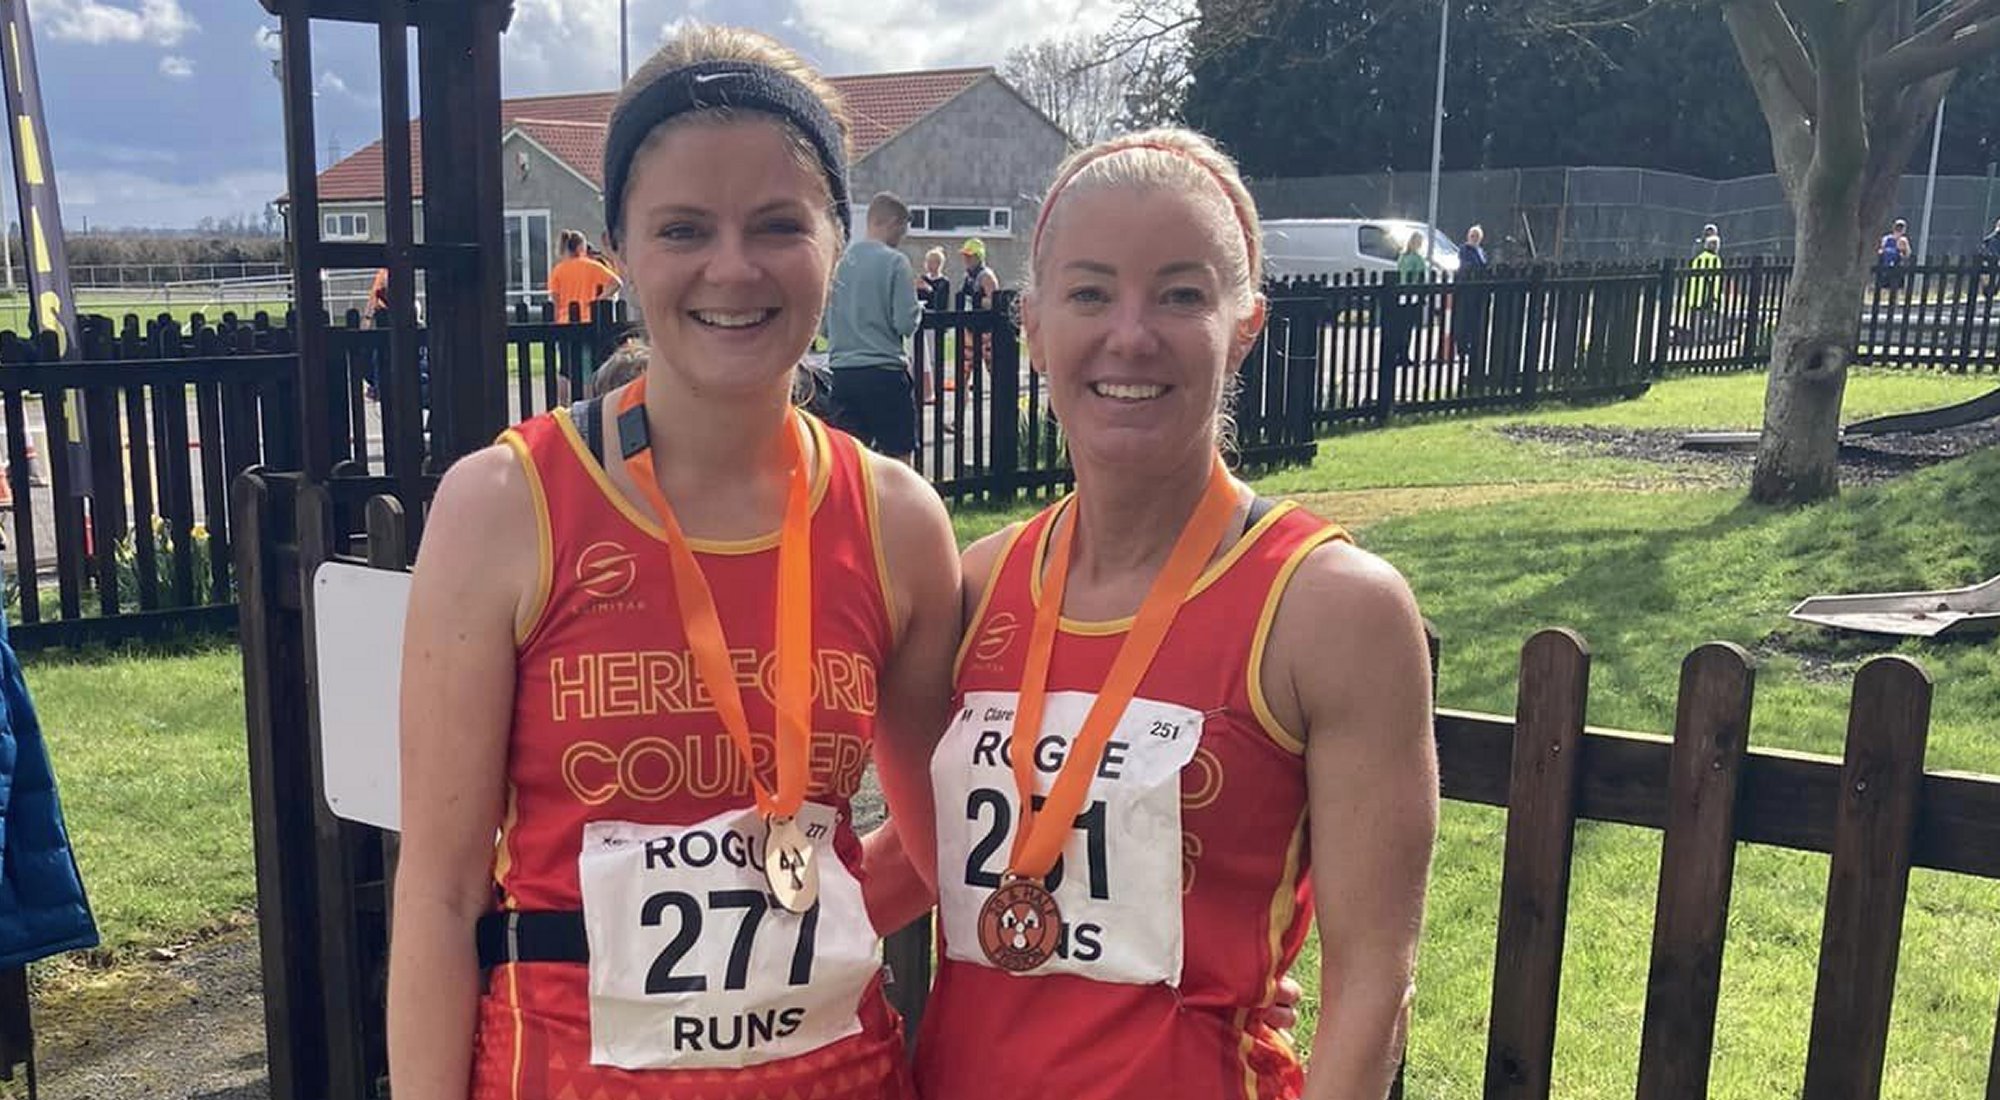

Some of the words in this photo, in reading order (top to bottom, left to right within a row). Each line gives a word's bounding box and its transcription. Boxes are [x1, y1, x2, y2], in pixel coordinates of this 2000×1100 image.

[1149, 720, 1180, 741] 251
[973, 730, 1130, 780] RGE
[644, 828, 768, 871] ROGU
[806, 823, 828, 840] 277
[964, 787, 1110, 901] 21
[639, 889, 820, 996] 277
[673, 1006, 807, 1052] RUNS
